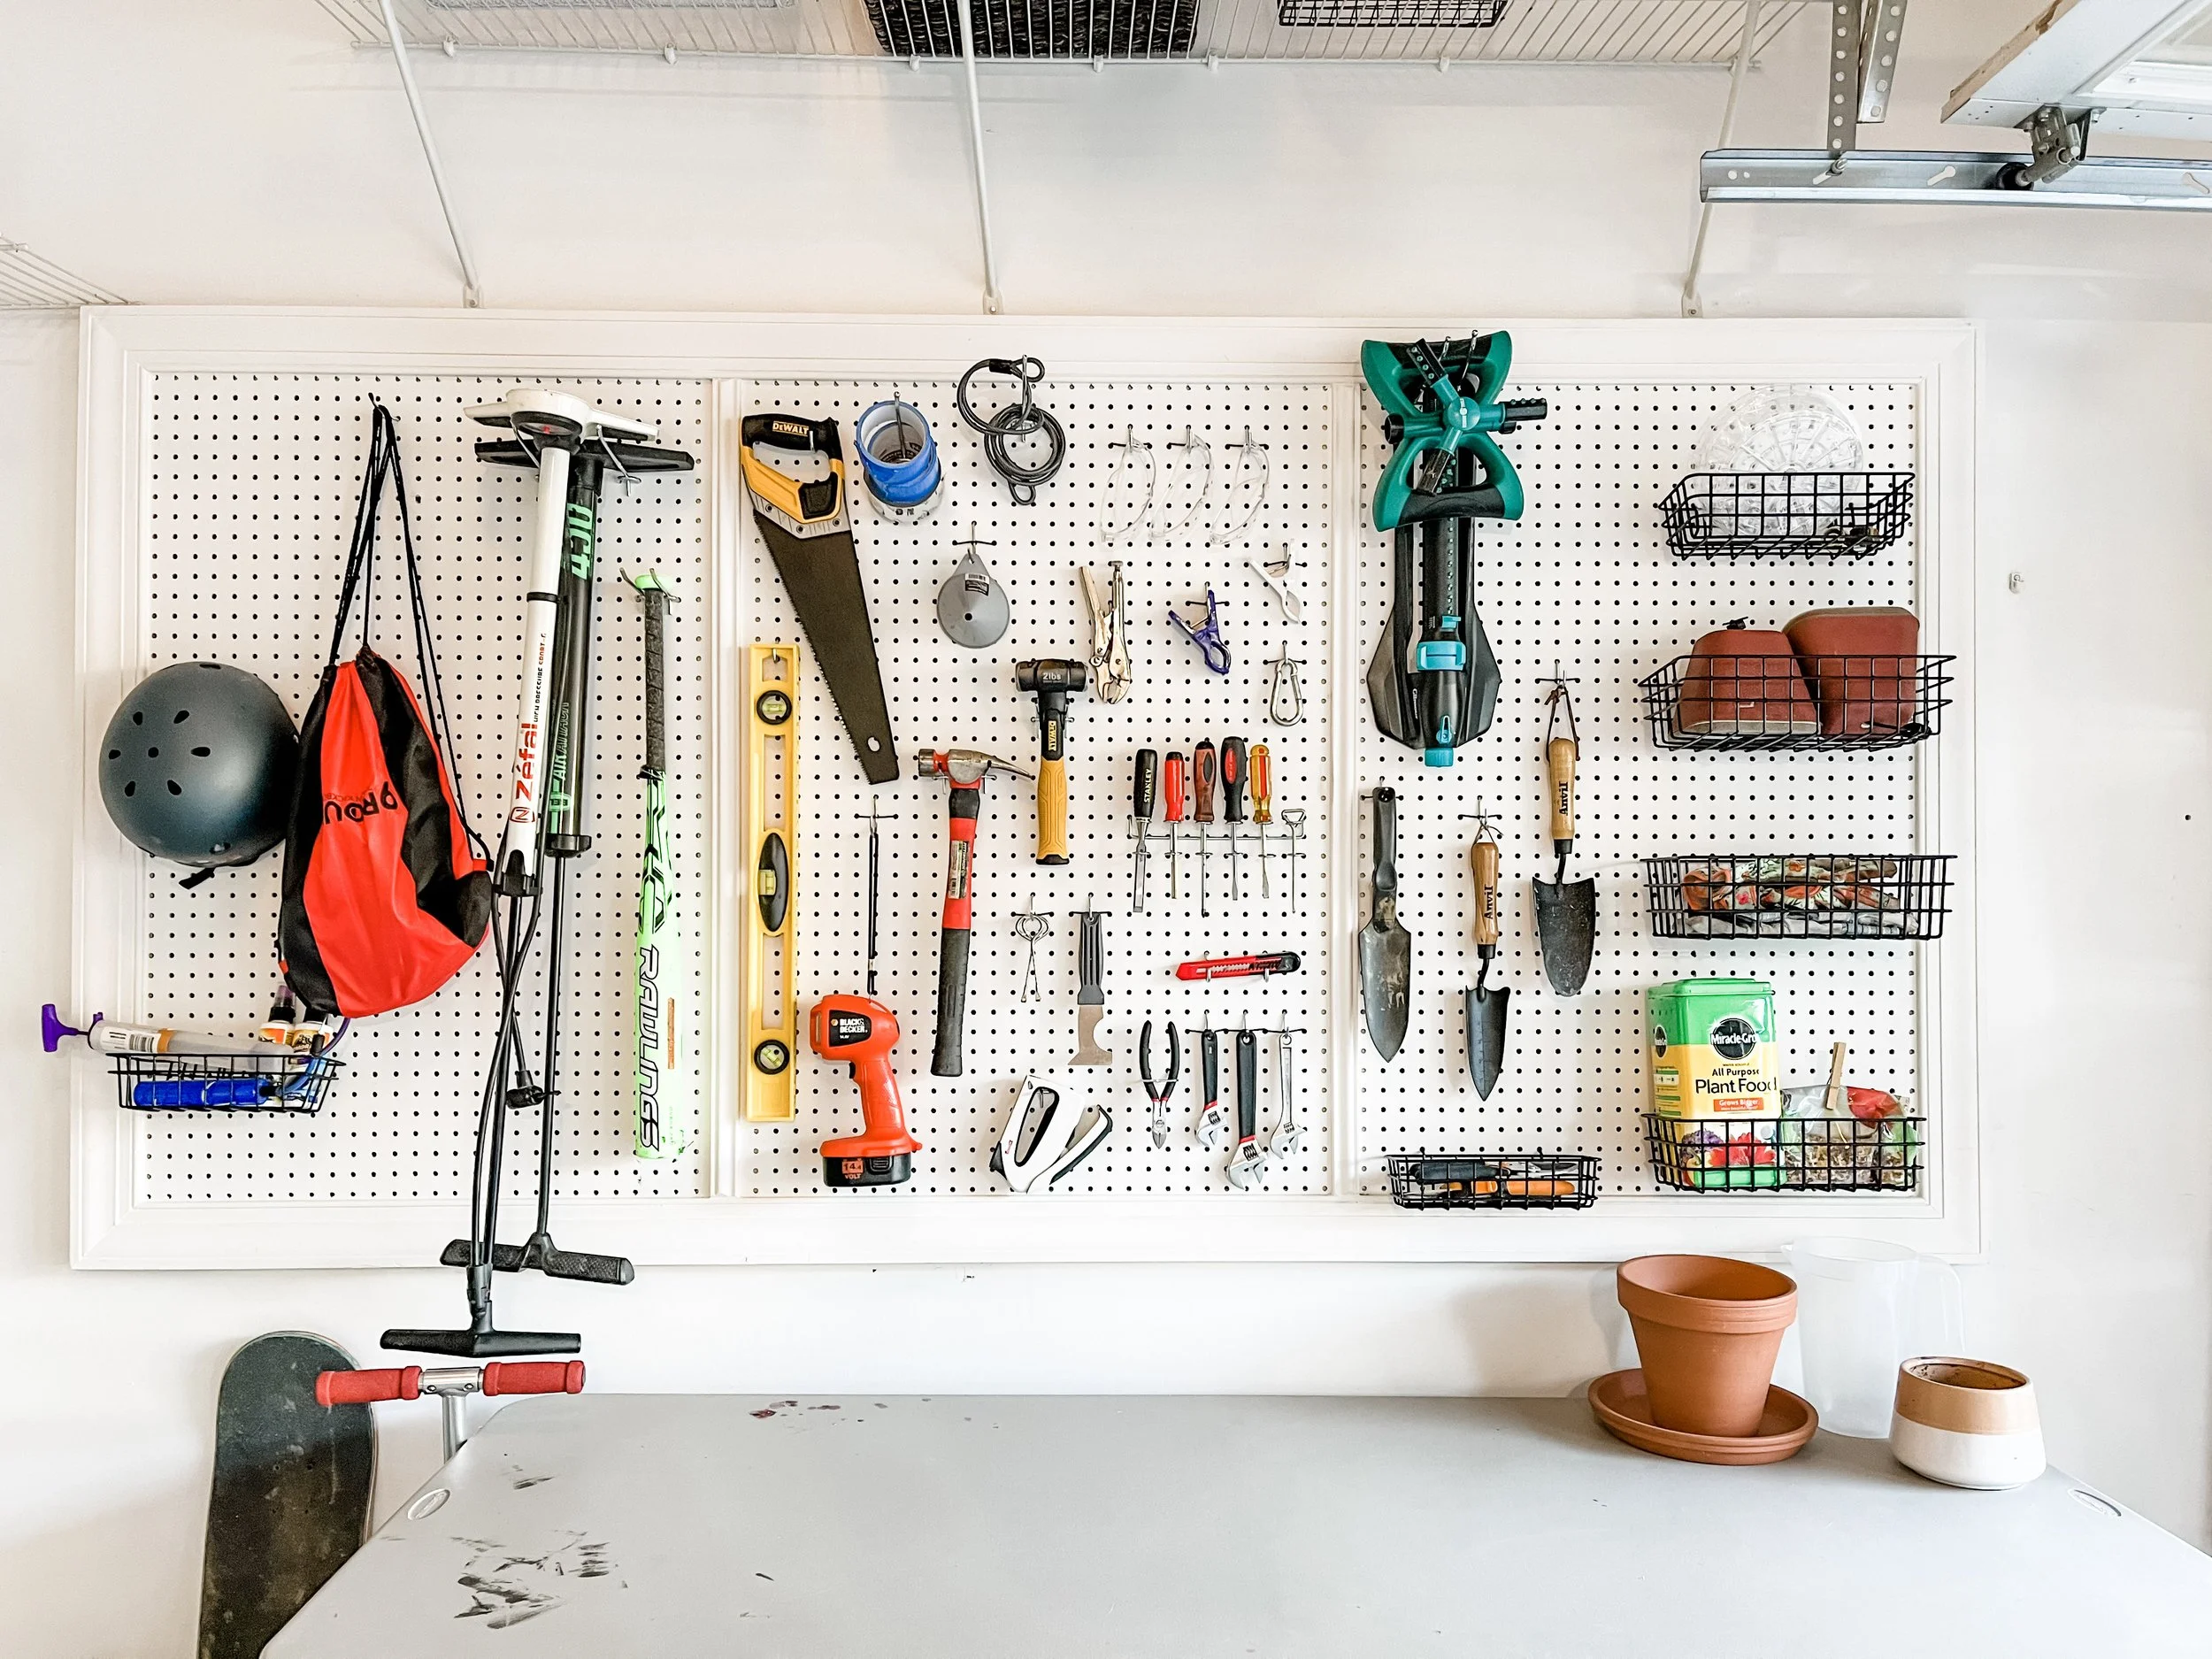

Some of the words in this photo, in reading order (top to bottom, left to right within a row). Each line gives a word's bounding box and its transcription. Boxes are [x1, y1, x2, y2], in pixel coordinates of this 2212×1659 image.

[1143, 768, 1152, 803] STANLEY
[1558, 781, 1569, 816] Anvil
[1484, 885, 1494, 919] Anvil
[639, 943, 660, 1152] RAWLINGS
[1710, 1031, 1757, 1045] Miracle-Gro
[1695, 1078, 1737, 1094] Plant
[1738, 1077, 1777, 1093] Food
[1711, 1067, 1724, 1077] All
